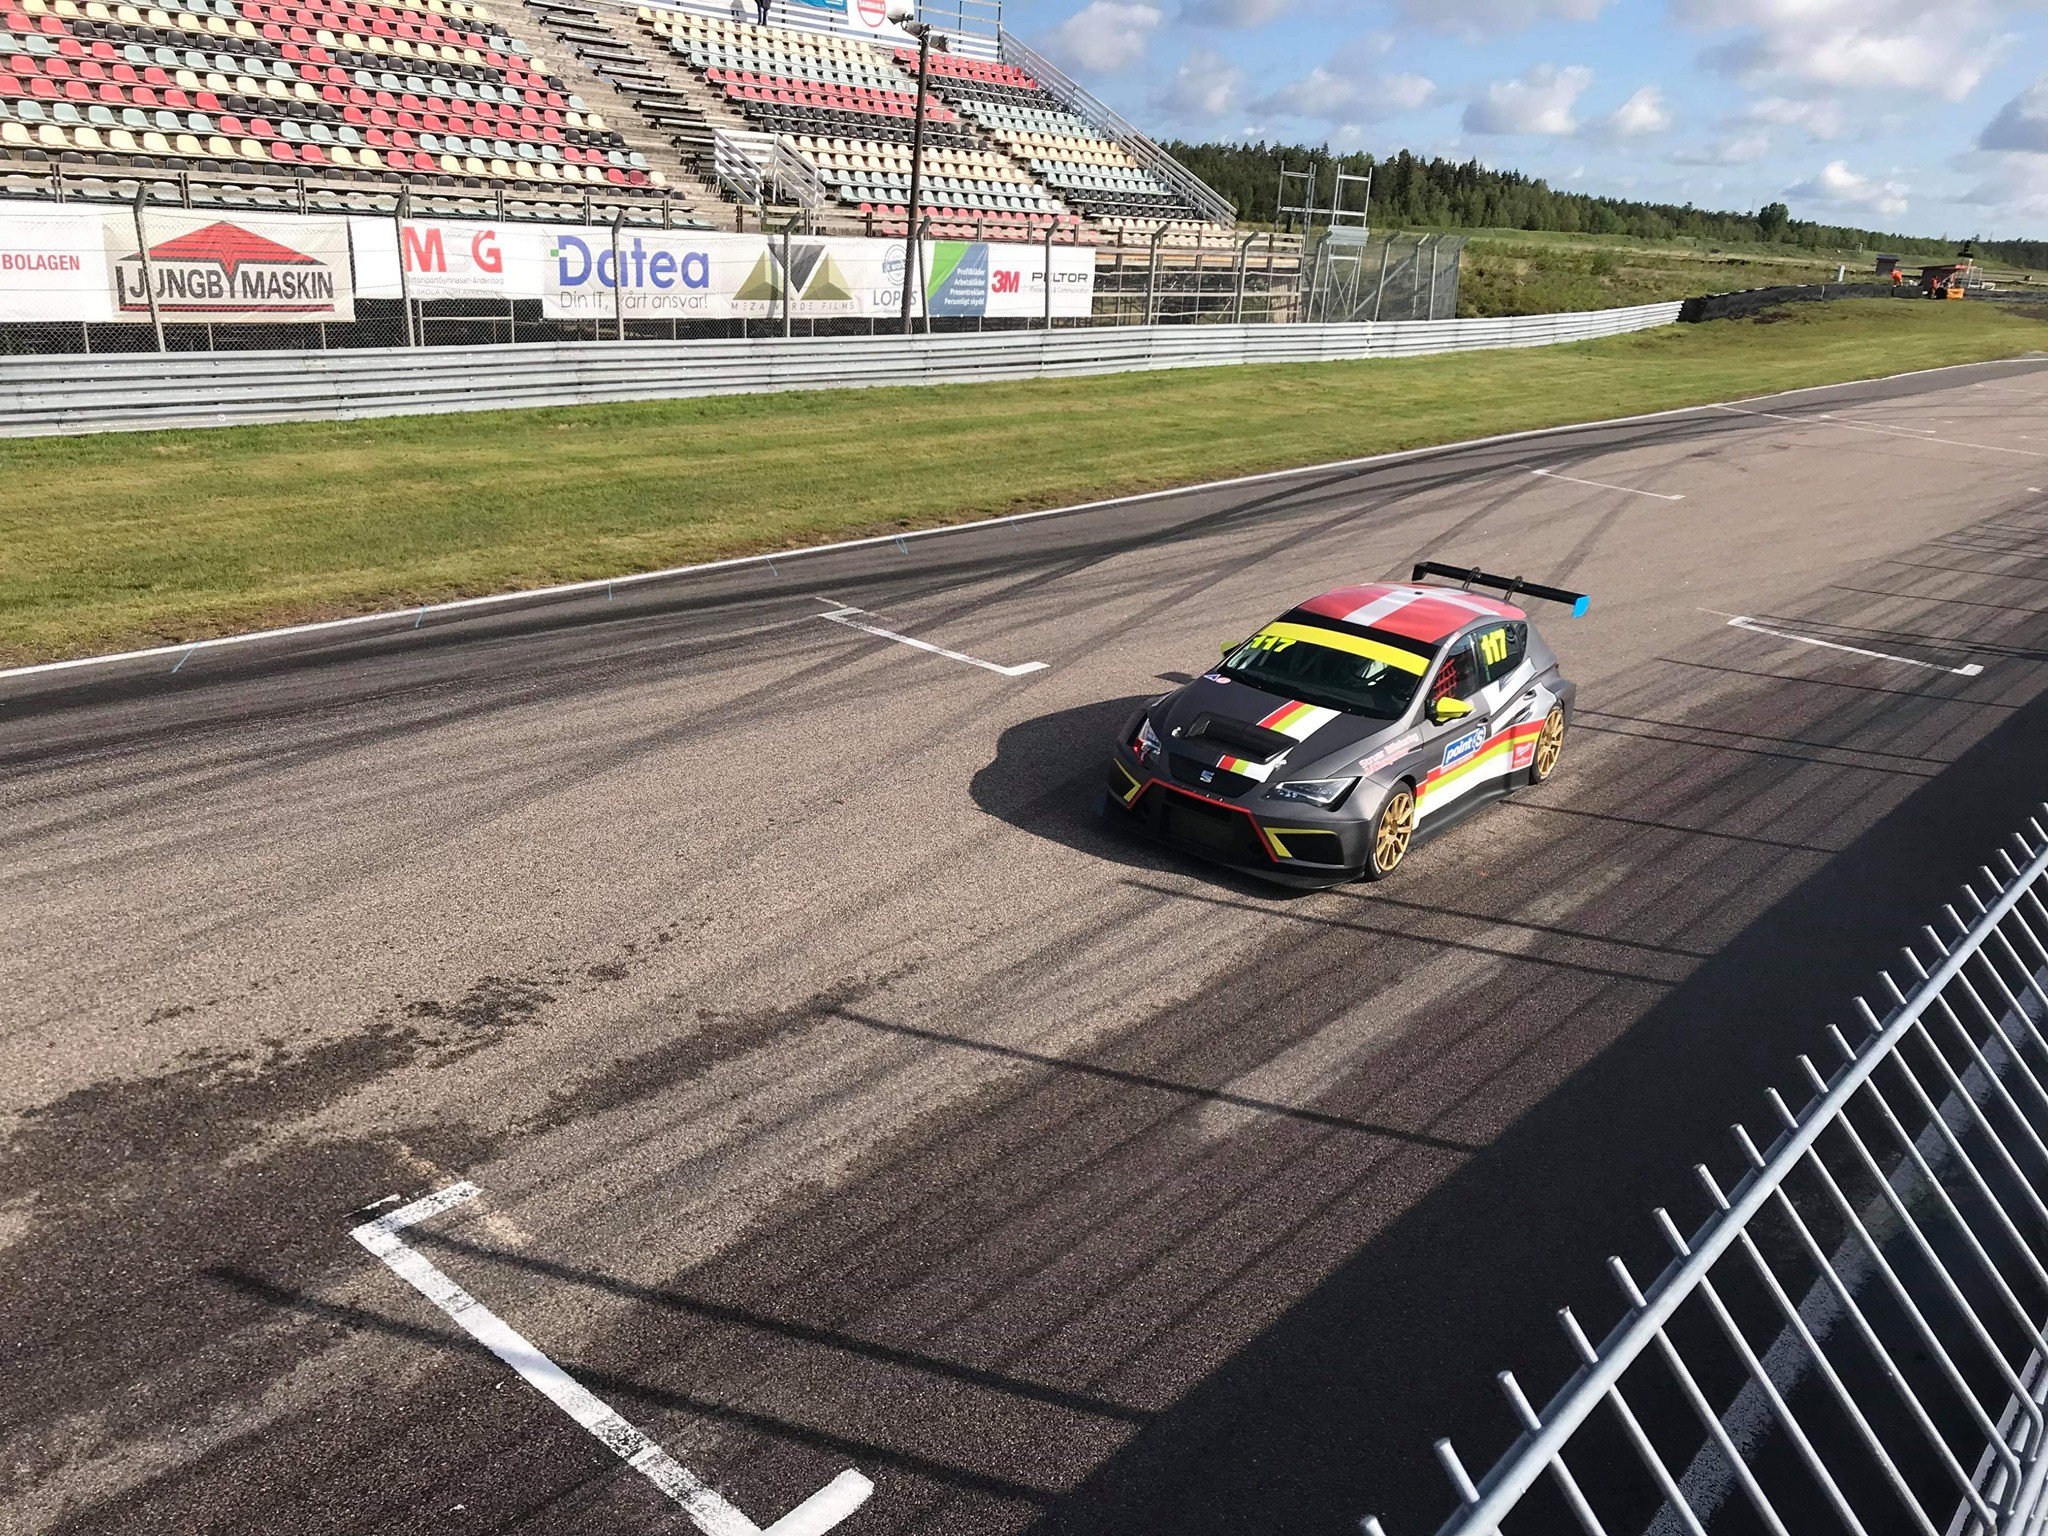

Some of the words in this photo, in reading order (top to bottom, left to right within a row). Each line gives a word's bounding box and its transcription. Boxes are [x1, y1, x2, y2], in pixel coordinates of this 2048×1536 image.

[1, 253, 80, 271] BOLAGEN
[557, 235, 709, 288] Datea
[991, 269, 1020, 293] 3M
[560, 291, 588, 309] Din
[592, 291, 608, 310] IT,
[652, 293, 709, 309] ansvar!
[774, 302, 813, 311] VRDE
[821, 302, 855, 311] FILMS
[873, 289, 918, 307] LOPS
[1251, 634, 1298, 653] 117
[1481, 628, 1507, 666] 117
[1445, 736, 1476, 764] point
